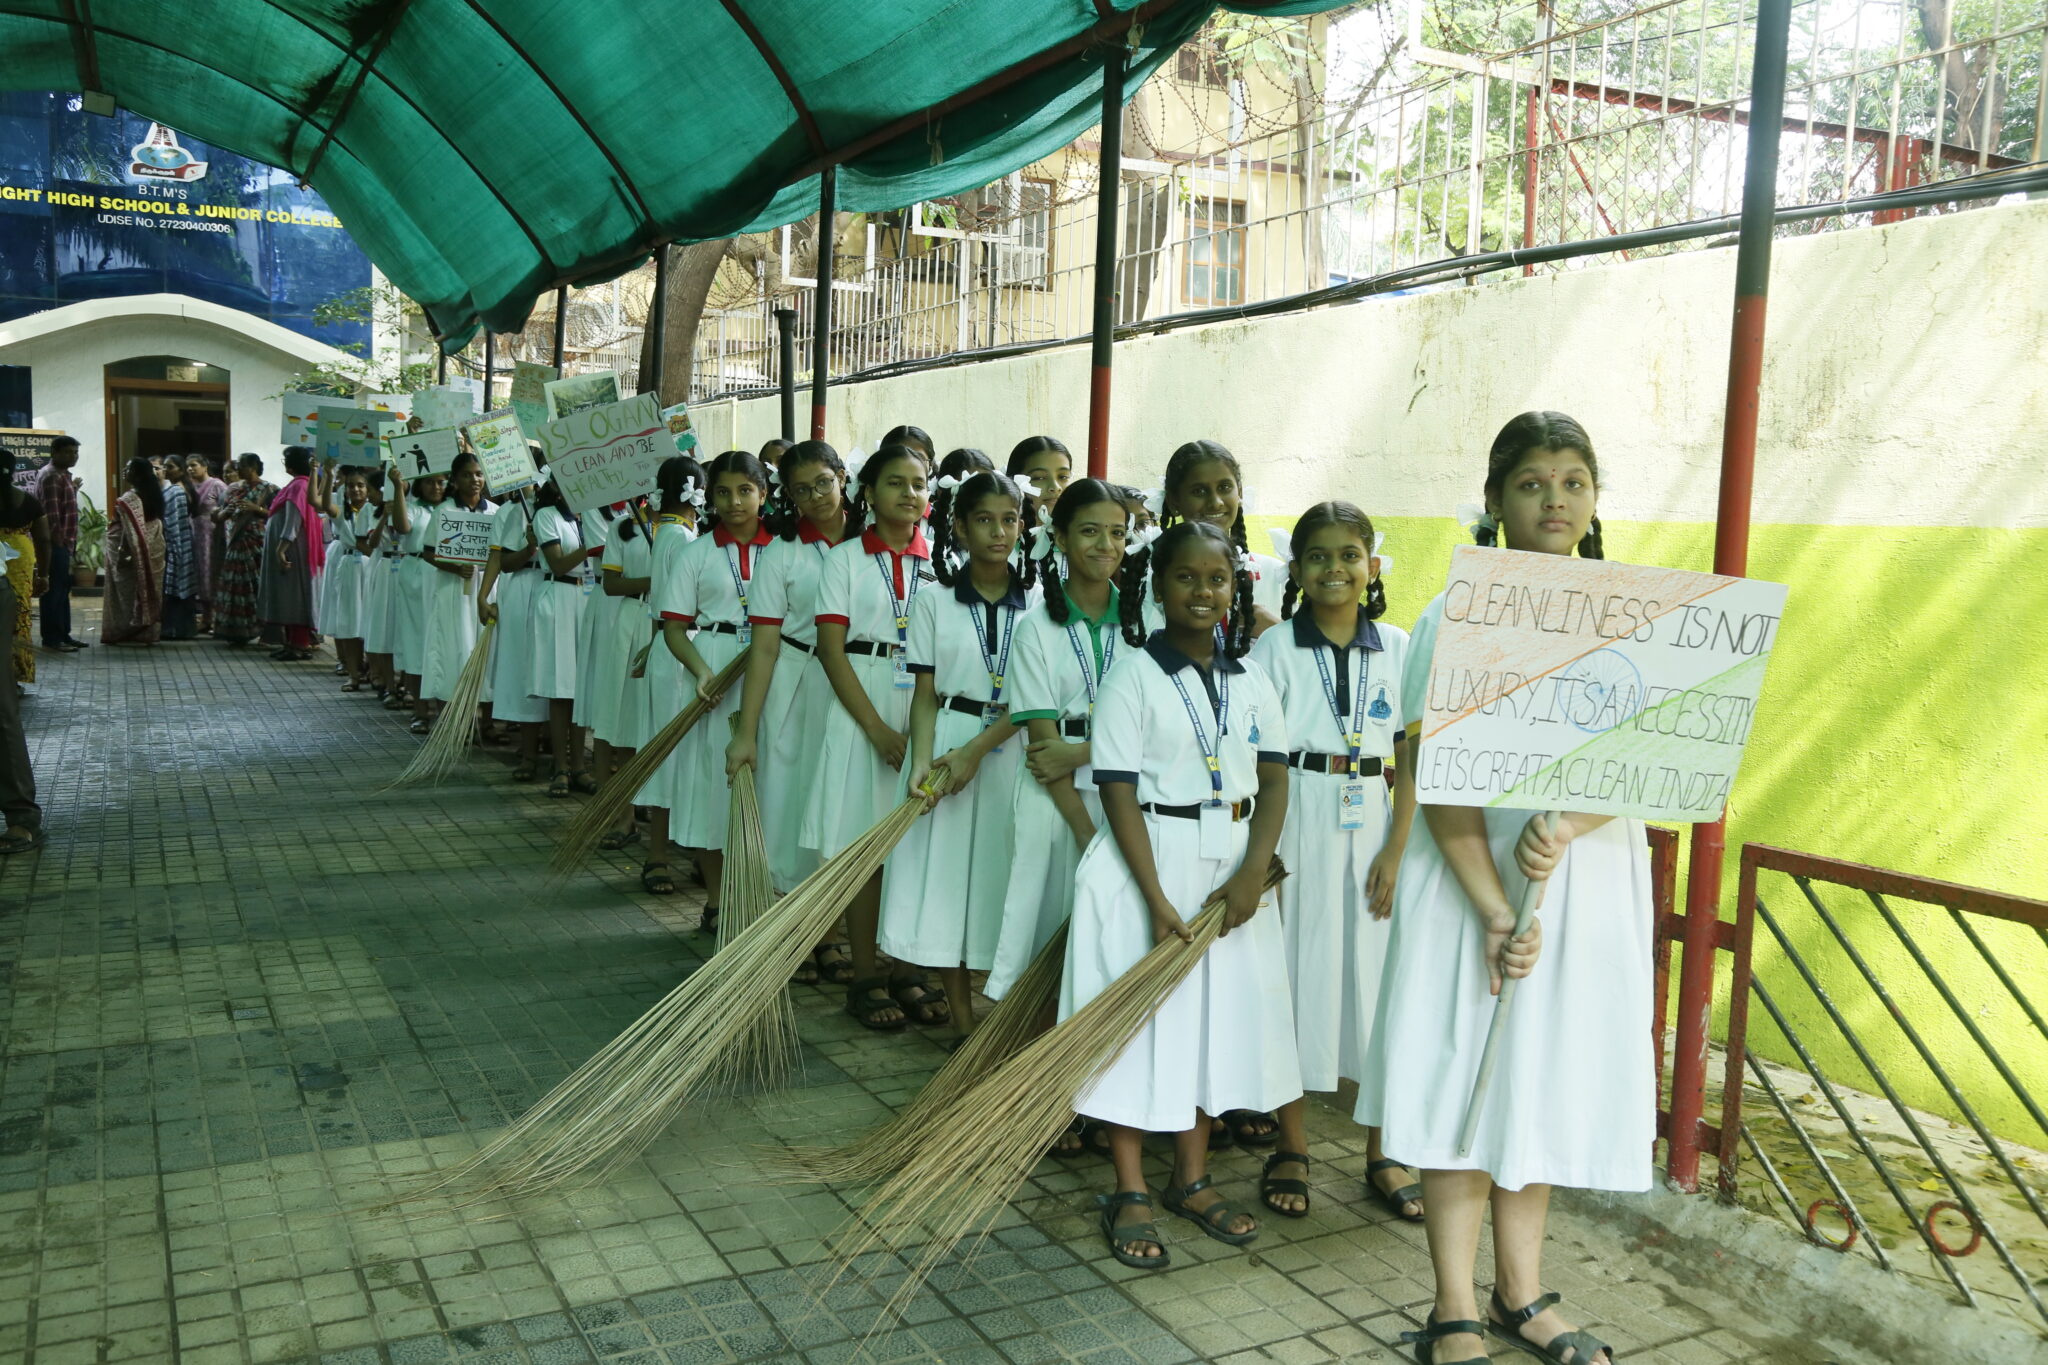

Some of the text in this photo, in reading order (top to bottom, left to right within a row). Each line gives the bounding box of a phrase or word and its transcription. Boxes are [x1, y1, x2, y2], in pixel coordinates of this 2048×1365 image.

[47, 191, 94, 208] HIGH
[99, 197, 175, 216] SCHOOL
[176, 202, 190, 216] &
[195, 204, 262, 222] JUNIOR
[266, 210, 344, 229] COLLEGE
[97, 213, 231, 234] UDISE NO. 27230400306
[2, 436, 53, 447] HIGH SCHOO
[609, 443, 635, 464] AND
[636, 437, 656, 455] BE
[1444, 580, 1781, 656] CLEANLINESS IS NOT
[1429, 667, 1545, 726] LUXURY,
[1617, 684, 1758, 746] NECESSITY
[1470, 750, 1553, 795] CREAT
[1565, 757, 1650, 804] CLEAN
[1648, 766, 1731, 812] INDIA
